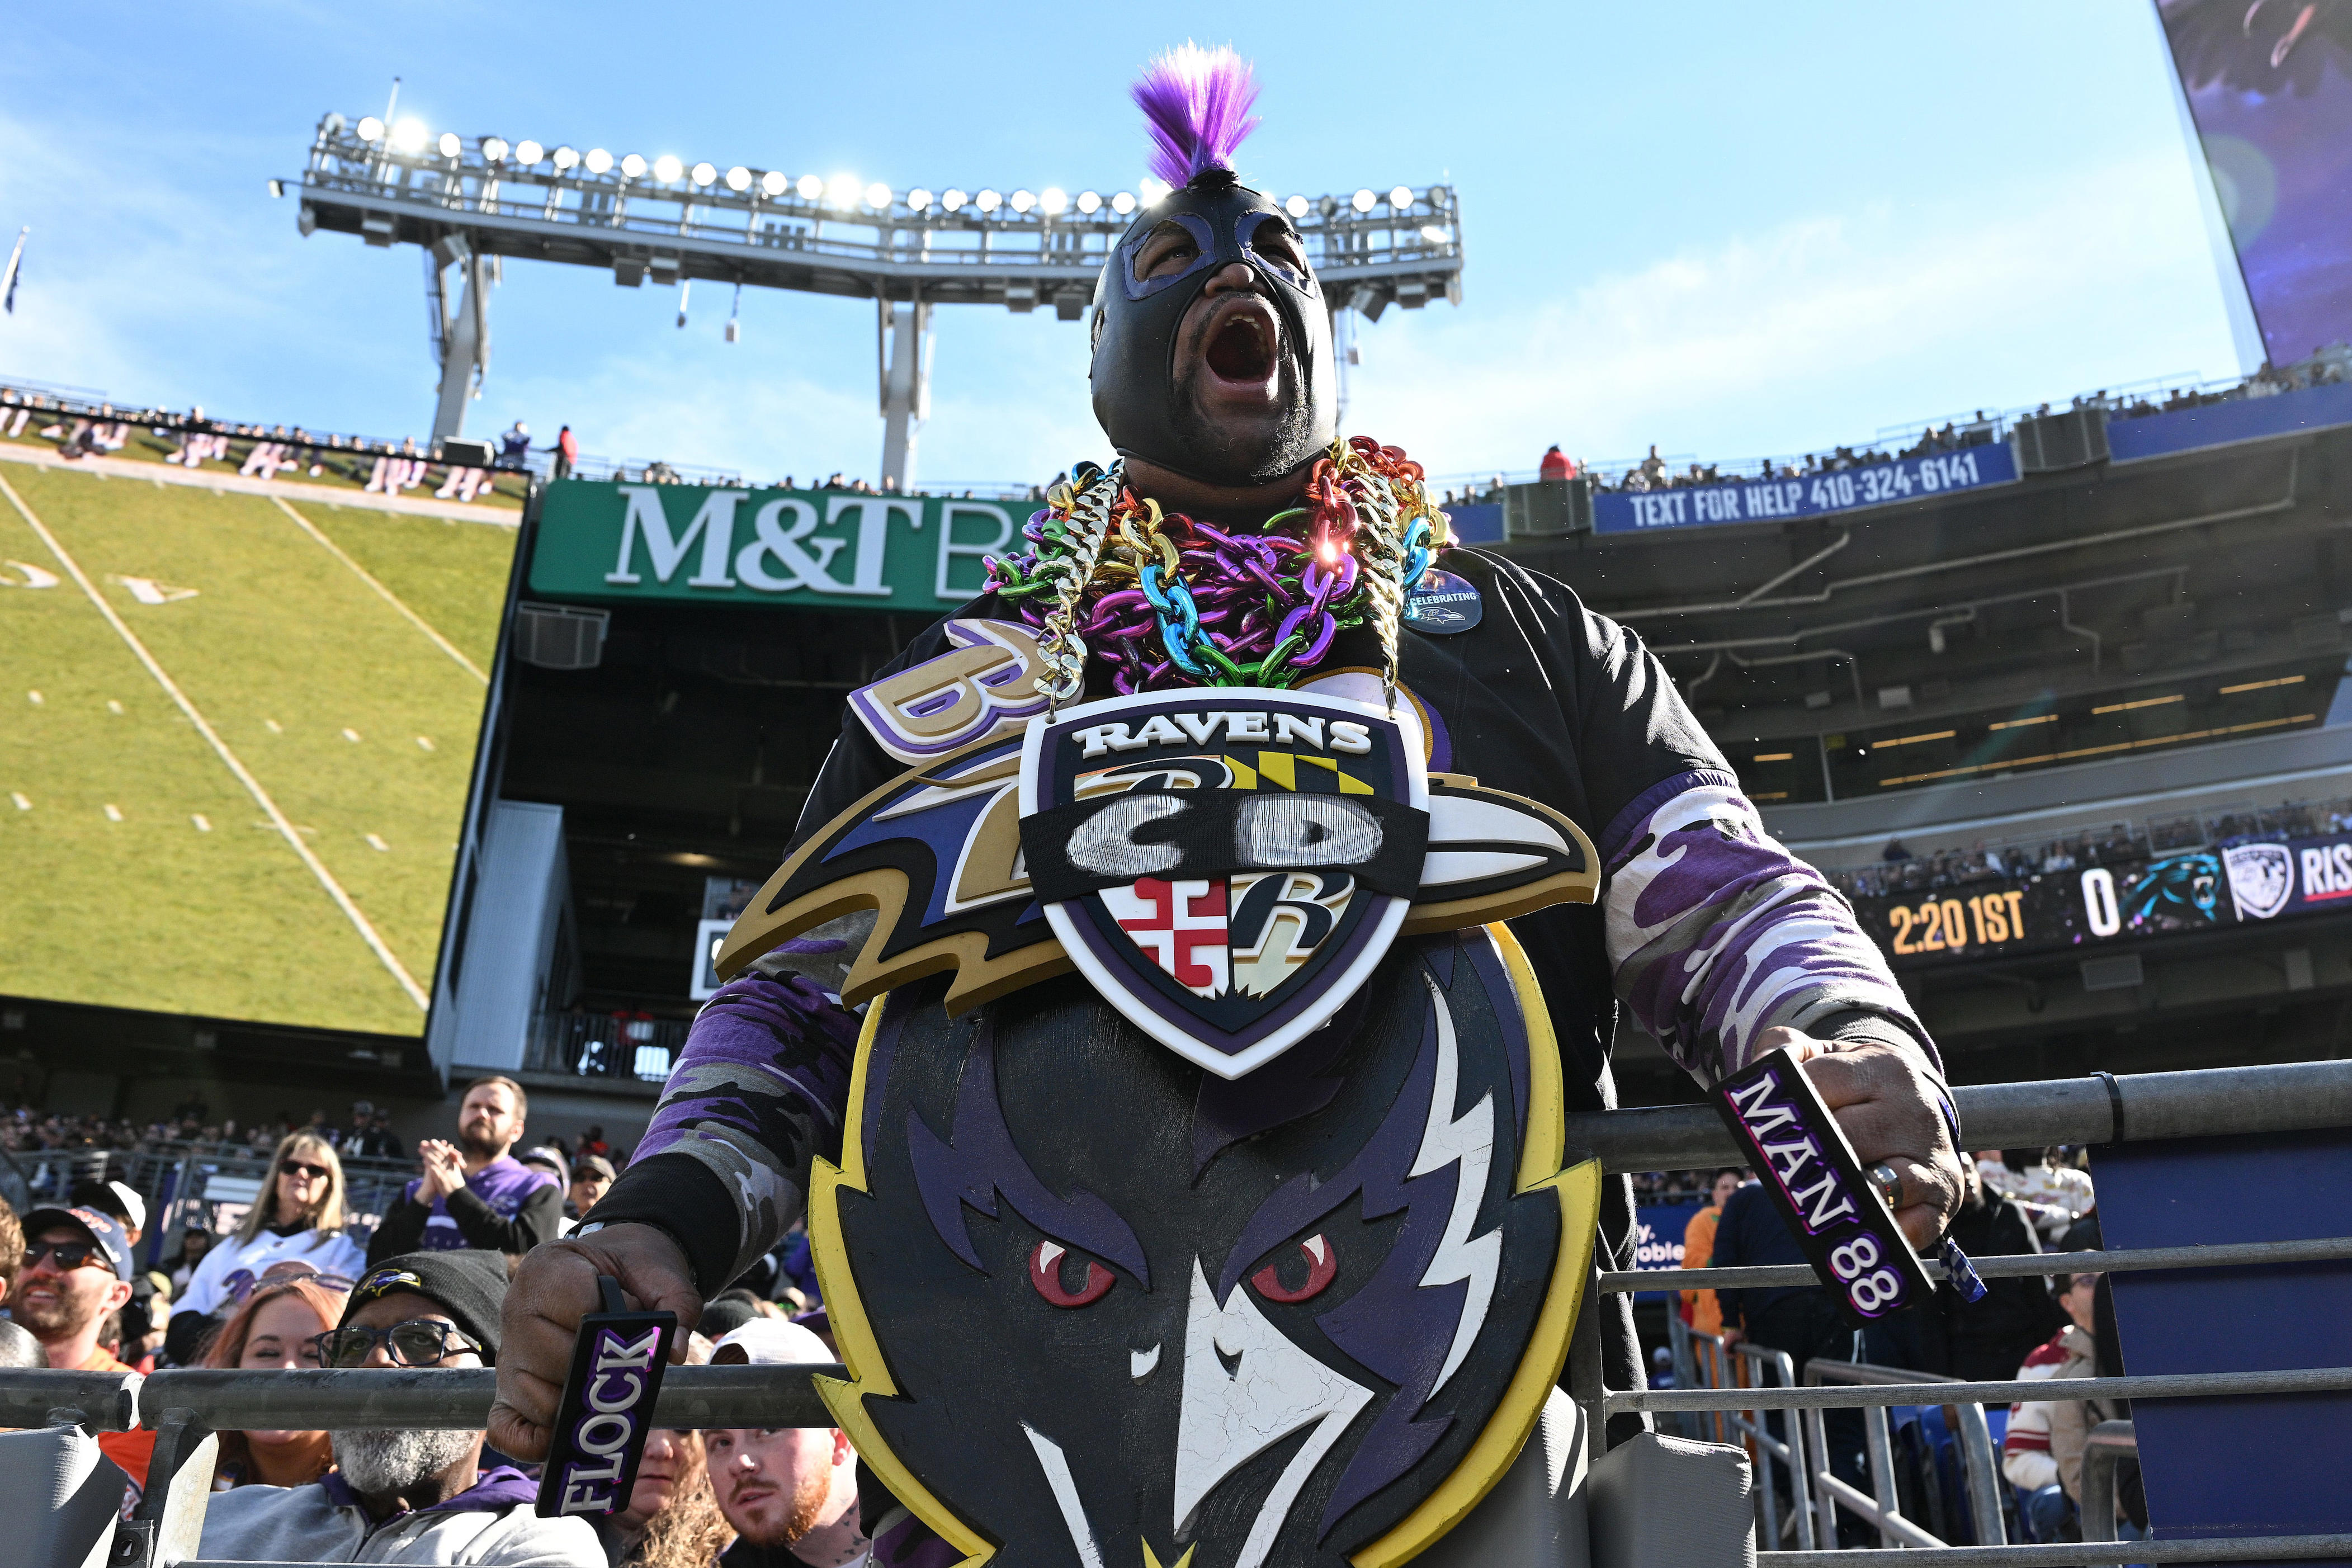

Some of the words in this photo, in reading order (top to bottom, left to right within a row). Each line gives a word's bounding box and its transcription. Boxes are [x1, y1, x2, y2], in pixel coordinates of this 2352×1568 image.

[1629, 492, 1687, 527] TEXT
[1693, 487, 1740, 522] FOR
[1744, 481, 1803, 518] HELP
[1810, 451, 1980, 509] 410-324-6141
[604, 485, 923, 597] M&T
[1409, 592, 1477, 606] CELEBRATING
[1072, 711, 1371, 759] RAVENS
[2301, 843, 2352, 896] RIS
[1889, 899, 1967, 955] 2:20
[1968, 890, 2025, 944] 1ST
[2081, 870, 2121, 937] 0
[1731, 1073, 1855, 1228] MAN
[1830, 1237, 1899, 1311] 88
[560, 1333, 657, 1516] FLOCK
